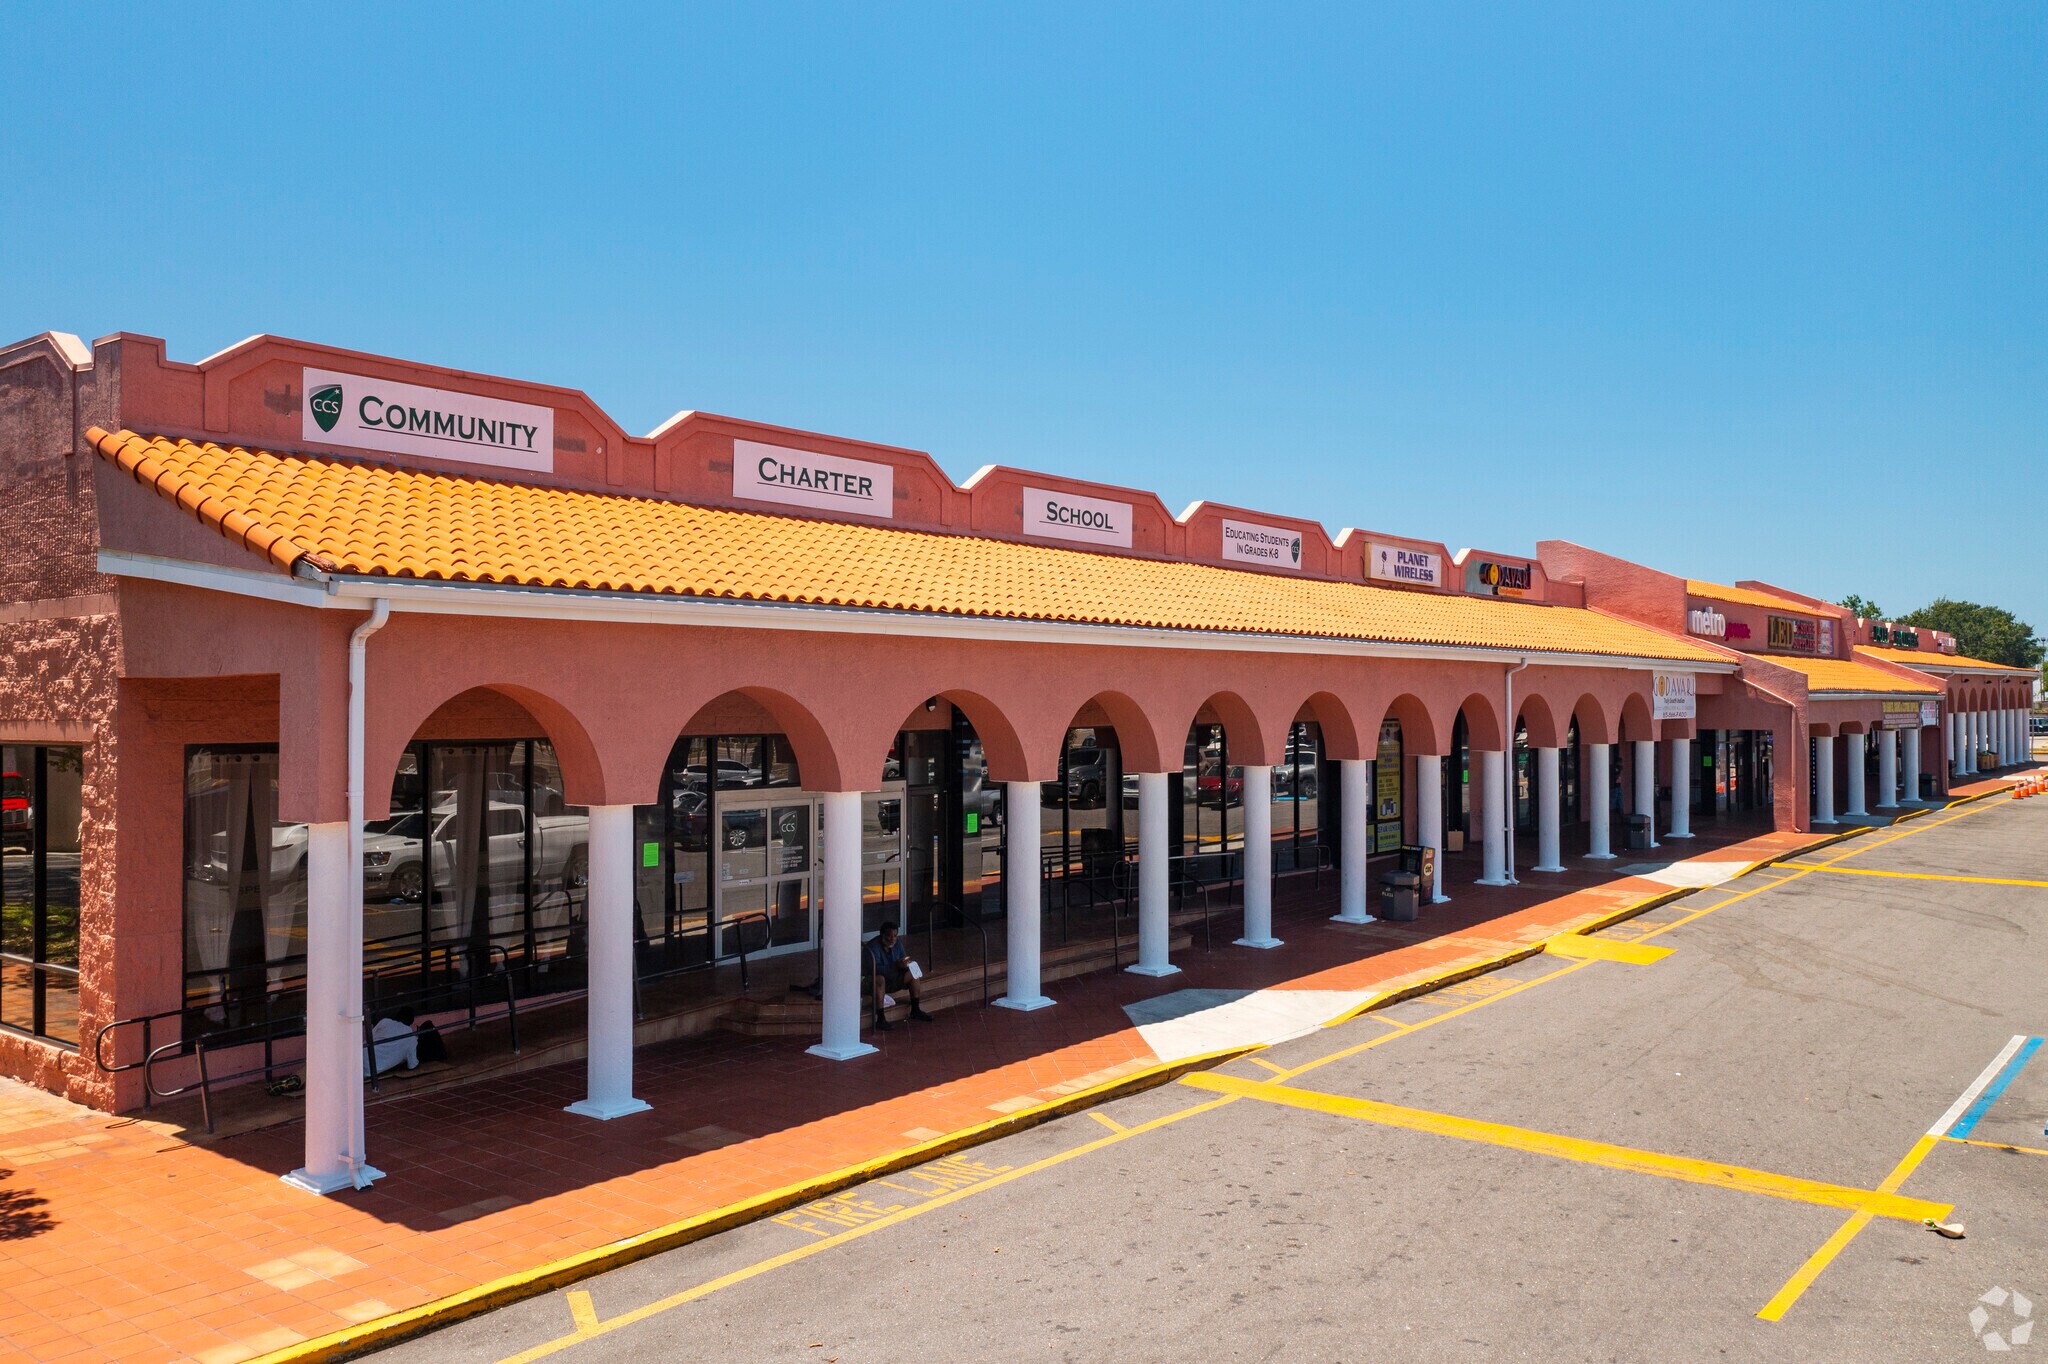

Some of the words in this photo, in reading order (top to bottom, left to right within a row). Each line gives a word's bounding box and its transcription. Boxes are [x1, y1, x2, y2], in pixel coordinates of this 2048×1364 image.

[312, 398, 339, 414] CCS
[358, 395, 538, 448] COMMUNITY
[758, 457, 873, 497] CHARTER
[1046, 501, 1113, 530] SCHOOL
[1225, 527, 1259, 543] EDUCATING
[1260, 533, 1289, 547] STUDENTS
[1236, 543, 1243, 554] IN
[1244, 544, 1268, 558] GRADES
[1269, 548, 1279, 559] K-8
[1397, 551, 1429, 567] PLANET
[1394, 565, 1434, 582] WIRELESS
[1690, 606, 1725, 637] metro
[781, 823, 796, 833] CCS
[771, 1192, 905, 1236] FIRE
[879, 1154, 1014, 1198] LANE
